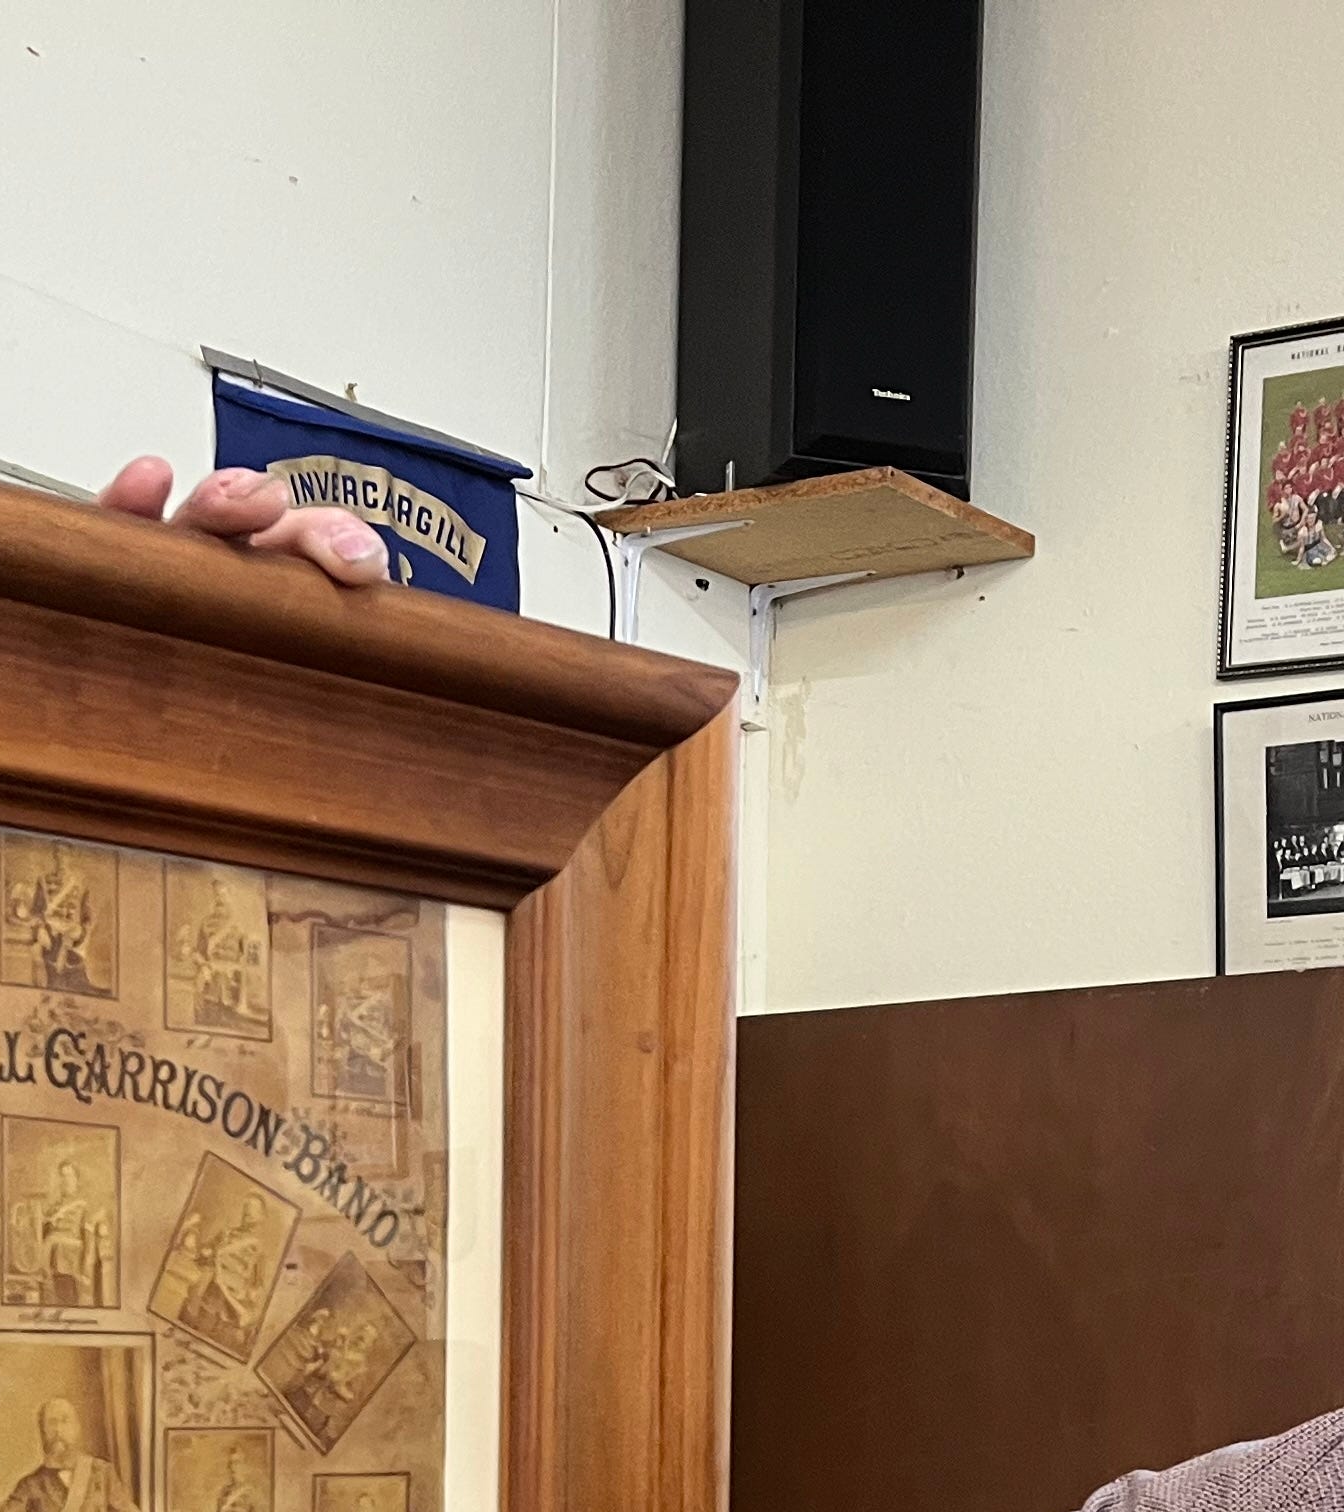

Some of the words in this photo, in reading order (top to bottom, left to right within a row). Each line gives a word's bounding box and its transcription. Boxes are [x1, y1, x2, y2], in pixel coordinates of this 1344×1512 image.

[289, 470, 469, 566] INVERCARGILL
[43, 1027, 285, 1157] GARRISON
[284, 1123, 400, 1248] BAND
